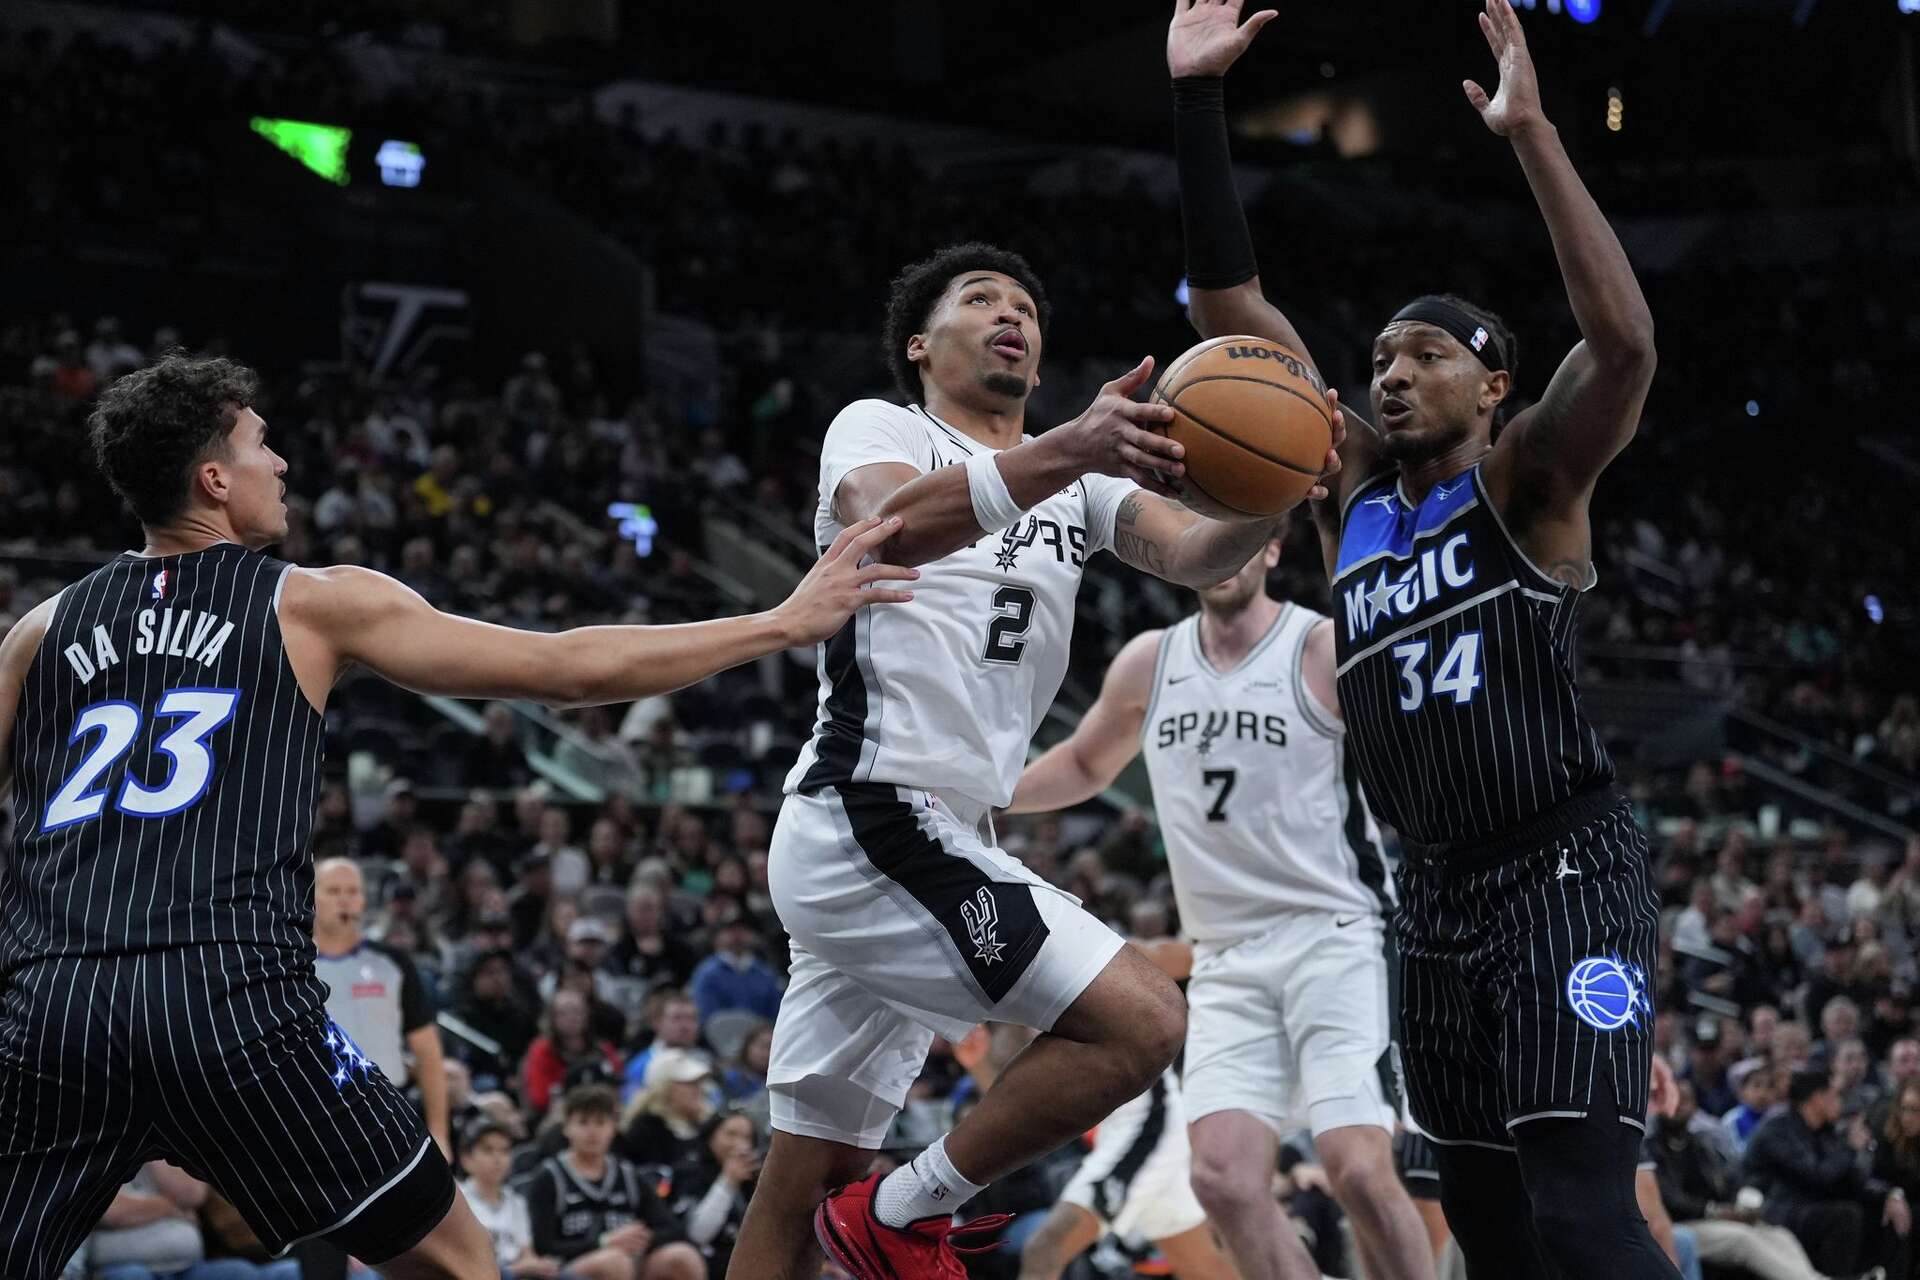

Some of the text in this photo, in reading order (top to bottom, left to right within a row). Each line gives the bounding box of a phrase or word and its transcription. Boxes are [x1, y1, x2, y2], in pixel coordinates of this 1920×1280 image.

[967, 514, 1087, 574] URS
[982, 583, 1037, 665] 2
[1343, 531, 1475, 644] MAGIC
[63, 607, 235, 685] DA SILVA
[1391, 629, 1485, 713] 34
[40, 687, 243, 834] 23
[1157, 709, 1288, 756] SPURS
[1202, 768, 1237, 823] 7
